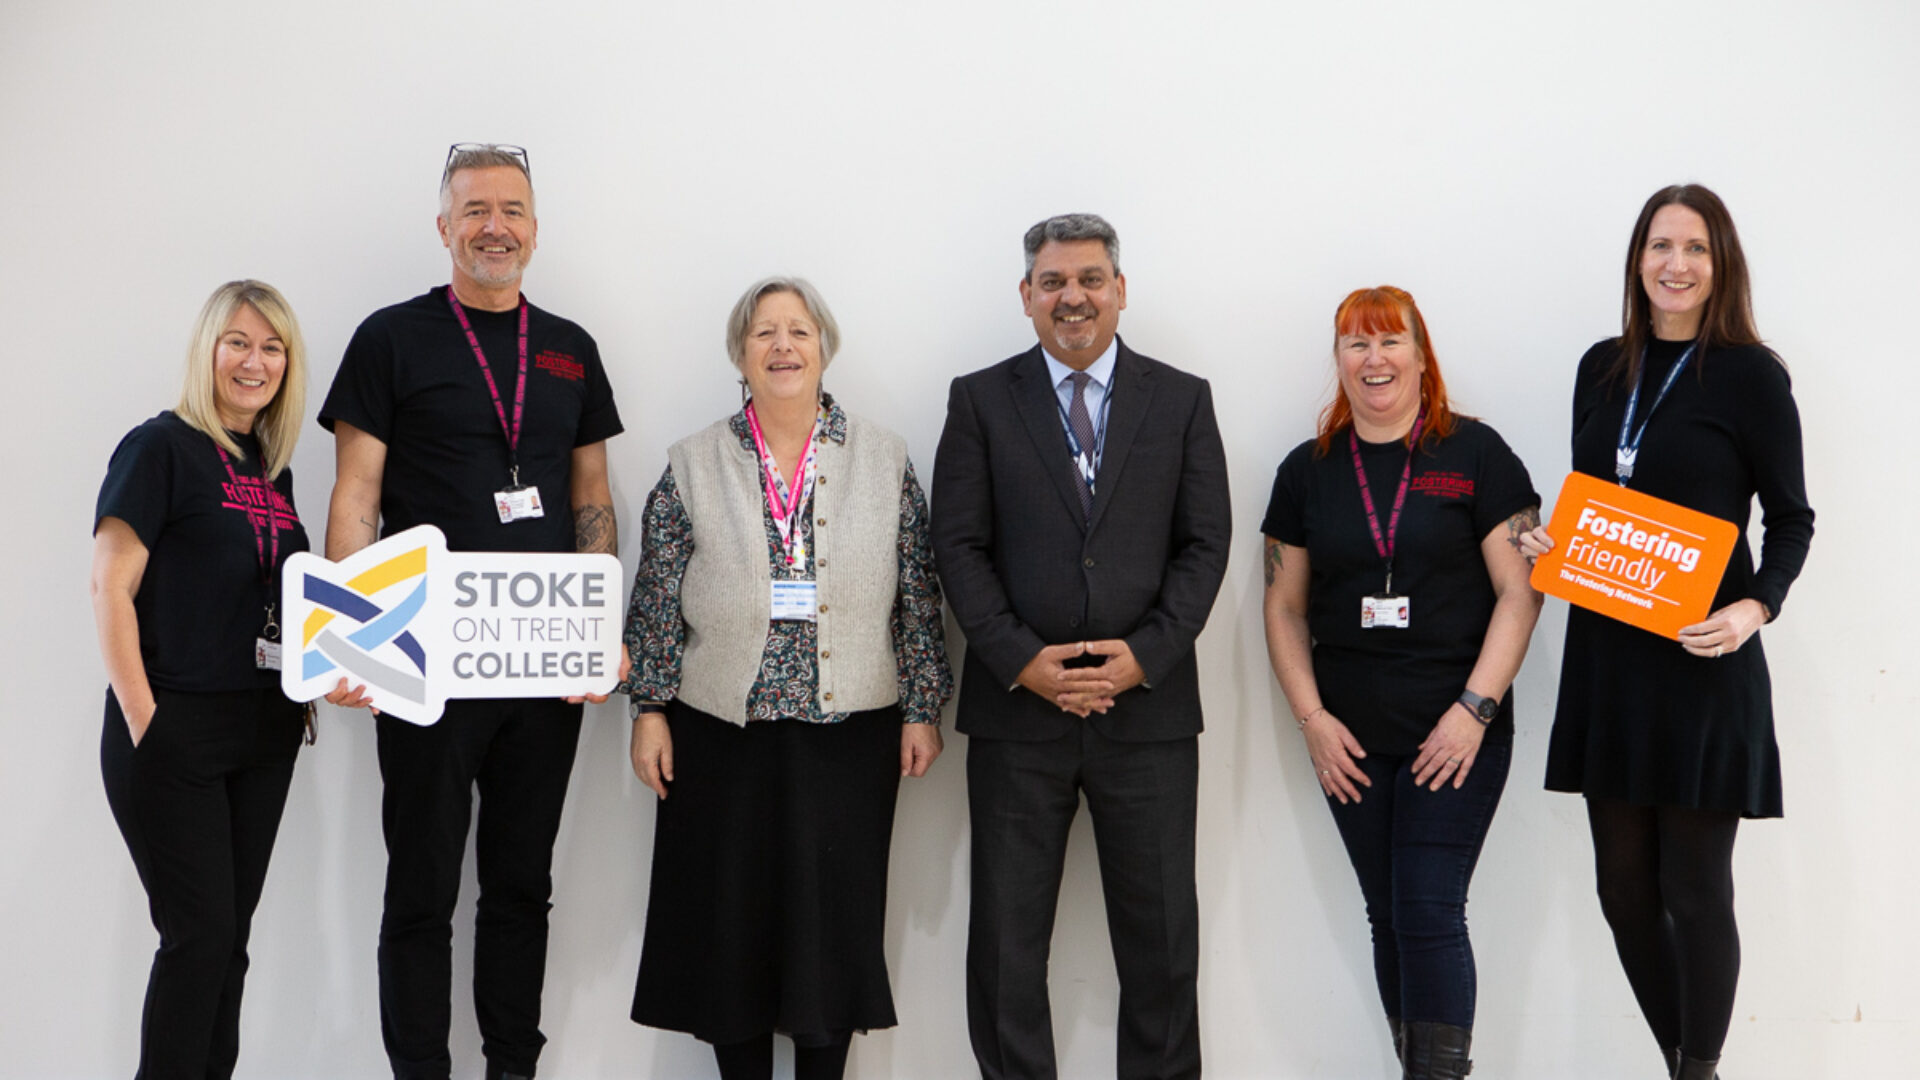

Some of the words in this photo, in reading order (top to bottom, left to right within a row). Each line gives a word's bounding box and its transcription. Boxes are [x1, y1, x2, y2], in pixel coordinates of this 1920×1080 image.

[1412, 477, 1474, 491] FOSTERING
[1576, 507, 1701, 573] Fostering
[1565, 536, 1666, 591] Friendly
[454, 571, 605, 608] STOKE
[1559, 569, 1575, 582] The
[1575, 575, 1615, 598] Fostering
[1615, 588, 1654, 609] Network
[453, 617, 500, 642] ON
[510, 617, 605, 642] TRENT
[453, 652, 604, 679] COLLEGE
